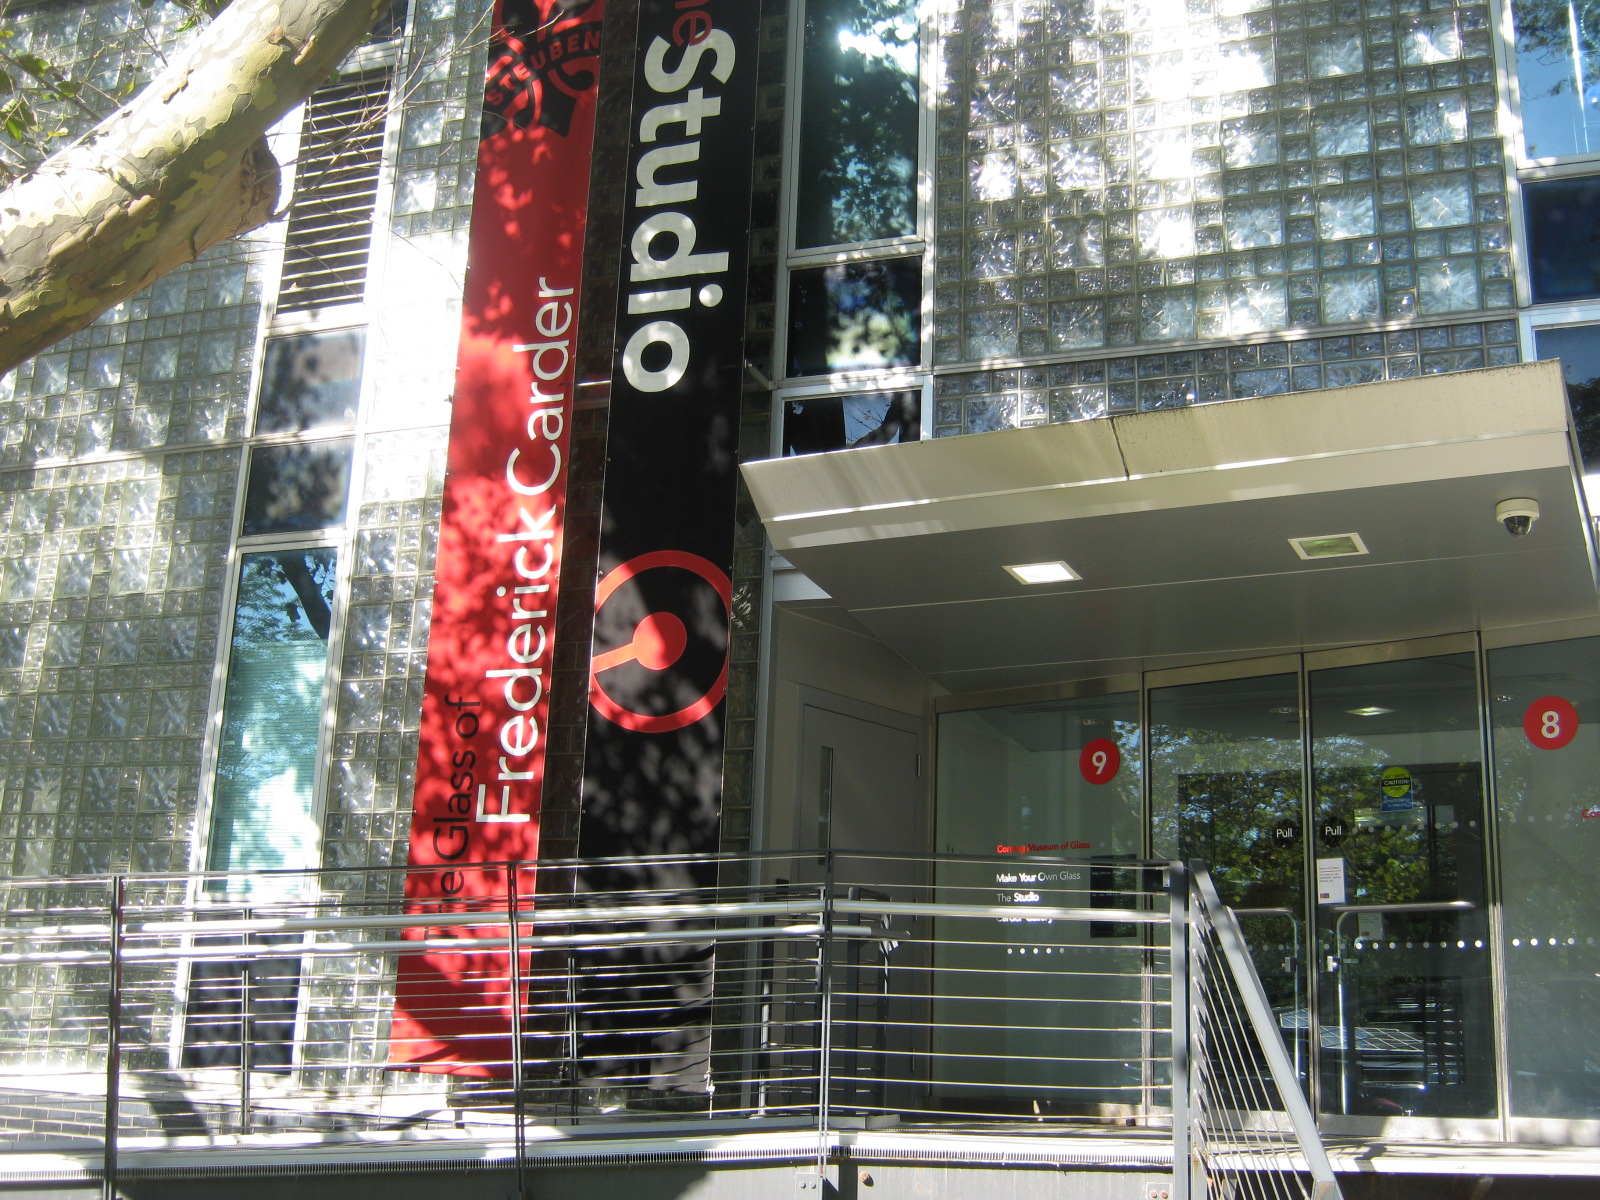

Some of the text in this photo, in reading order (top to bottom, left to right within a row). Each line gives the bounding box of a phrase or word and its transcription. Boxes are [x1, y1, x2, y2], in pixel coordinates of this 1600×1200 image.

[672, 0, 712, 47] e
[485, 30, 601, 106] STEUBEN
[622, 28, 736, 393] Studio
[475, 275, 575, 823] Frederick Carder
[444, 695, 480, 739] of
[1541, 711, 1559, 738] 8
[1092, 751, 1106, 774] 9
[432, 750, 476, 860] Glass
[1276, 827, 1293, 838] Pull
[1325, 825, 1342, 836] Pull
[1027, 842, 1059, 852] Museum
[1061, 841, 1070, 849] of
[1071, 840, 1091, 849] Glass
[996, 872, 1018, 883] Make
[1019, 872, 1036, 883] Your
[1037, 871, 1058, 882] Own
[1059, 870, 1081, 881] Glass
[997, 891, 1040, 903] The Studio
